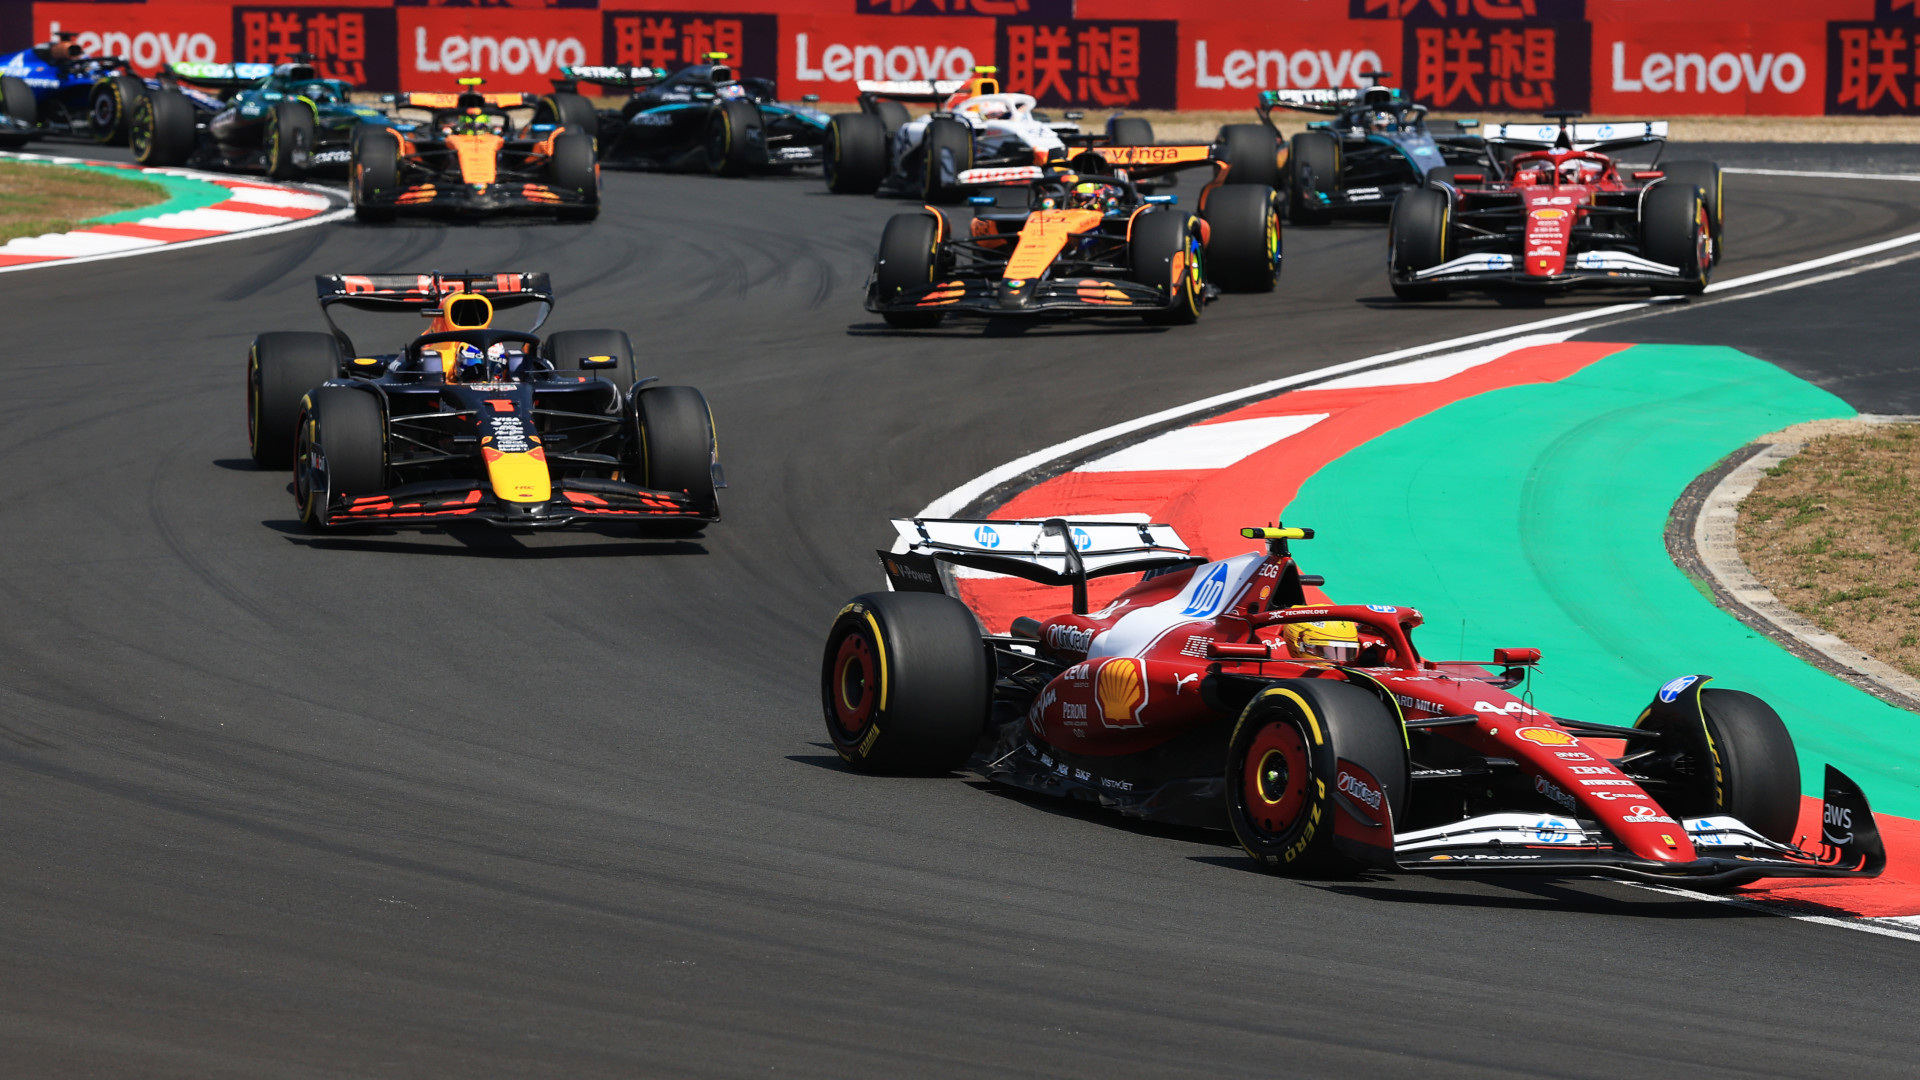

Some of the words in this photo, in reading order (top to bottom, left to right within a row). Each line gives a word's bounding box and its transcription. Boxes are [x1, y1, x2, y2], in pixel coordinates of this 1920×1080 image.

[243, 13, 366, 88] 联想
[416, 27, 585, 74] Lenovo
[614, 17, 743, 83] 联想
[797, 33, 975, 82] Lenovo
[1006, 25, 1140, 106] 联想
[1196, 41, 1381, 89] Lenovo
[1415, 28, 1556, 108] 联想
[1612, 42, 1806, 94] Lenovo
[1838, 28, 1920, 110] 联
[1277, 89, 1358, 103] PETRON
[1108, 147, 1178, 162] venga
[1532, 196, 1572, 206] 16
[976, 525, 999, 548] hp
[1187, 570, 1225, 616] hp
[1057, 624, 1096, 654] UniCredit
[1180, 635, 1215, 659] IBM
[1063, 702, 1087, 719] PERONI
[1415, 698, 1445, 715] MILLE
[1473, 701, 1540, 716] 44
[1568, 766, 1617, 775] IBM
[1316, 777, 1325, 800] P
[1823, 801, 1852, 830] aws
[1284, 802, 1322, 863] ZERO
[1536, 818, 1568, 843] hp
[1452, 853, 1542, 861] V-Power
